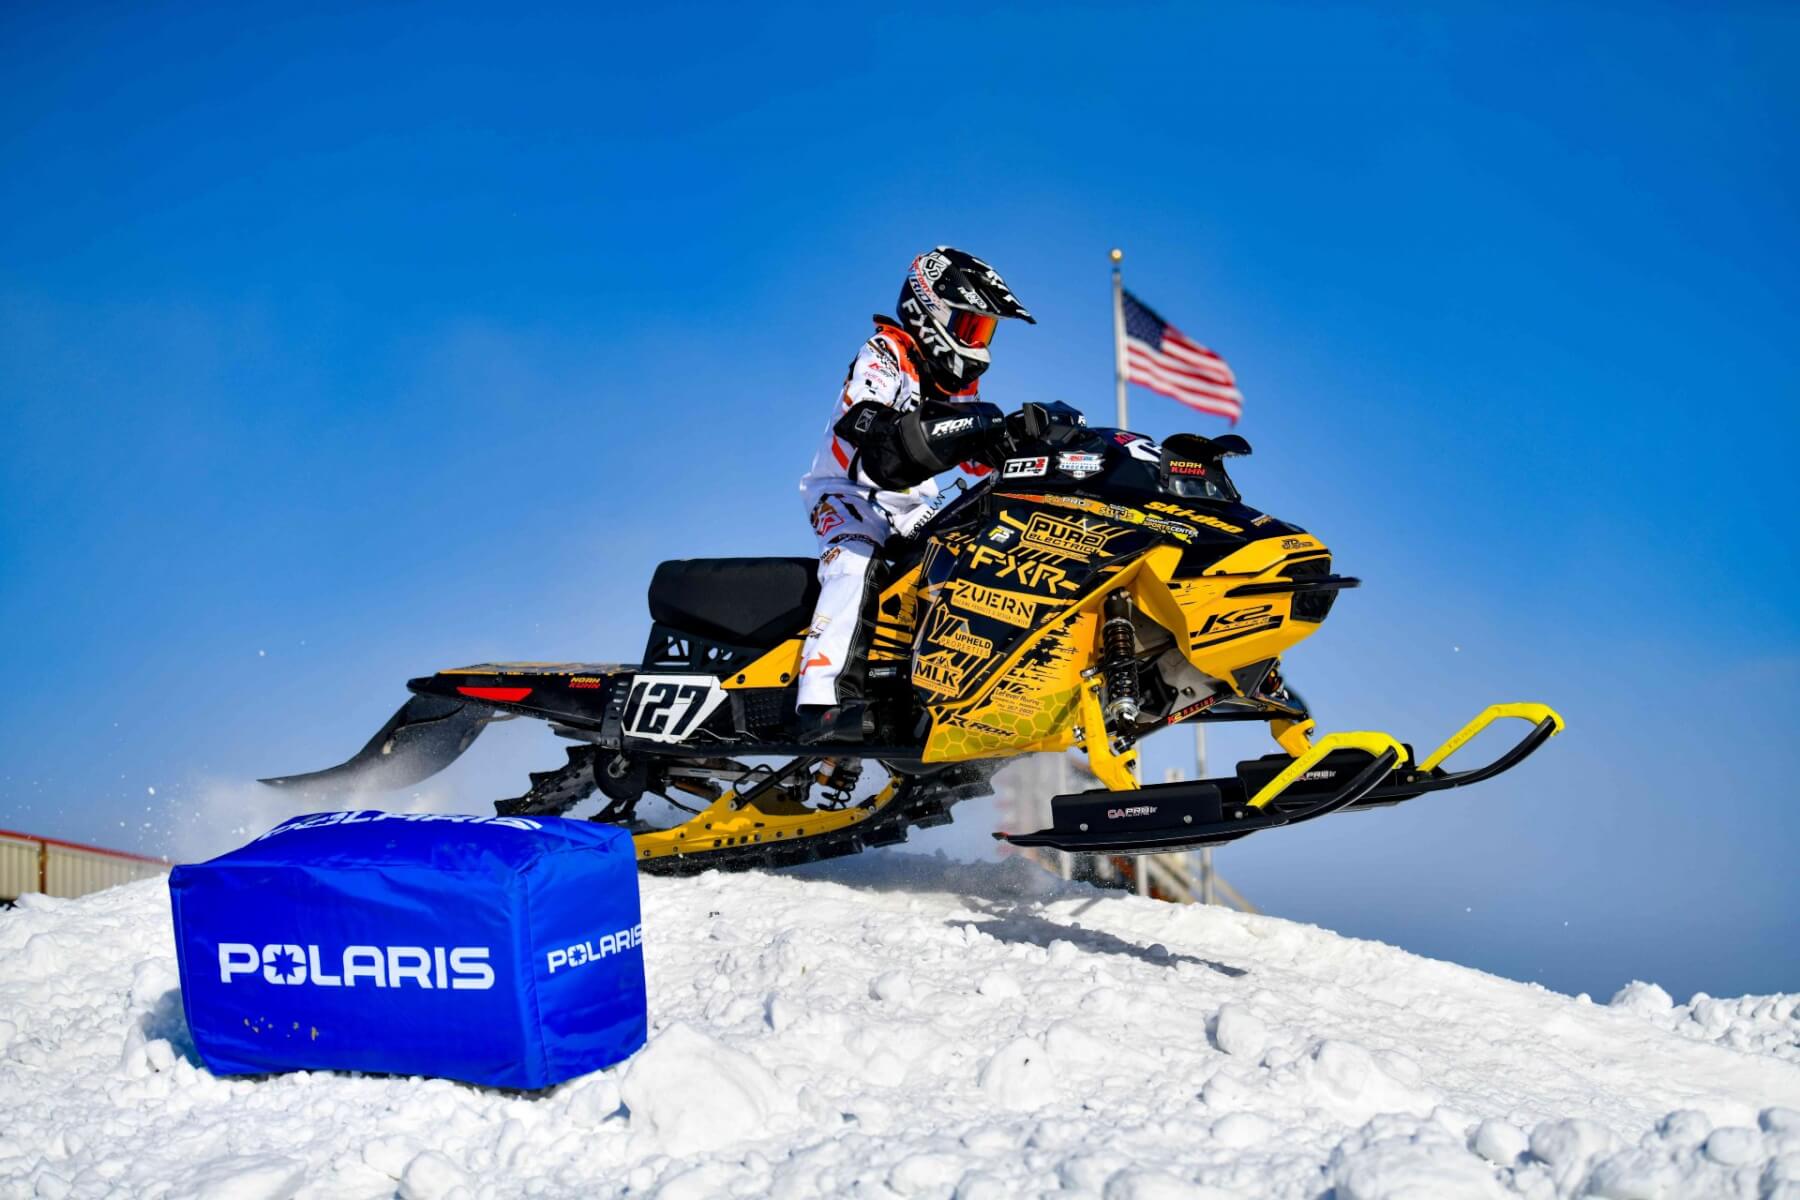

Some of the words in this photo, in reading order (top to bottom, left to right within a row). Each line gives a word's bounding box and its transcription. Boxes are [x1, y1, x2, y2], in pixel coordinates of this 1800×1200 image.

[902, 298, 952, 357] FXR
[931, 417, 973, 435] ROX
[1144, 501, 1245, 534] ski-doo
[970, 545, 1067, 594] FXR
[956, 583, 1033, 619] ZUERN
[955, 633, 991, 649] UPHELD
[915, 661, 957, 689] MLK
[622, 682, 712, 736] 127
[217, 943, 495, 990] POLARIS
[547, 923, 642, 974] POLARIS
